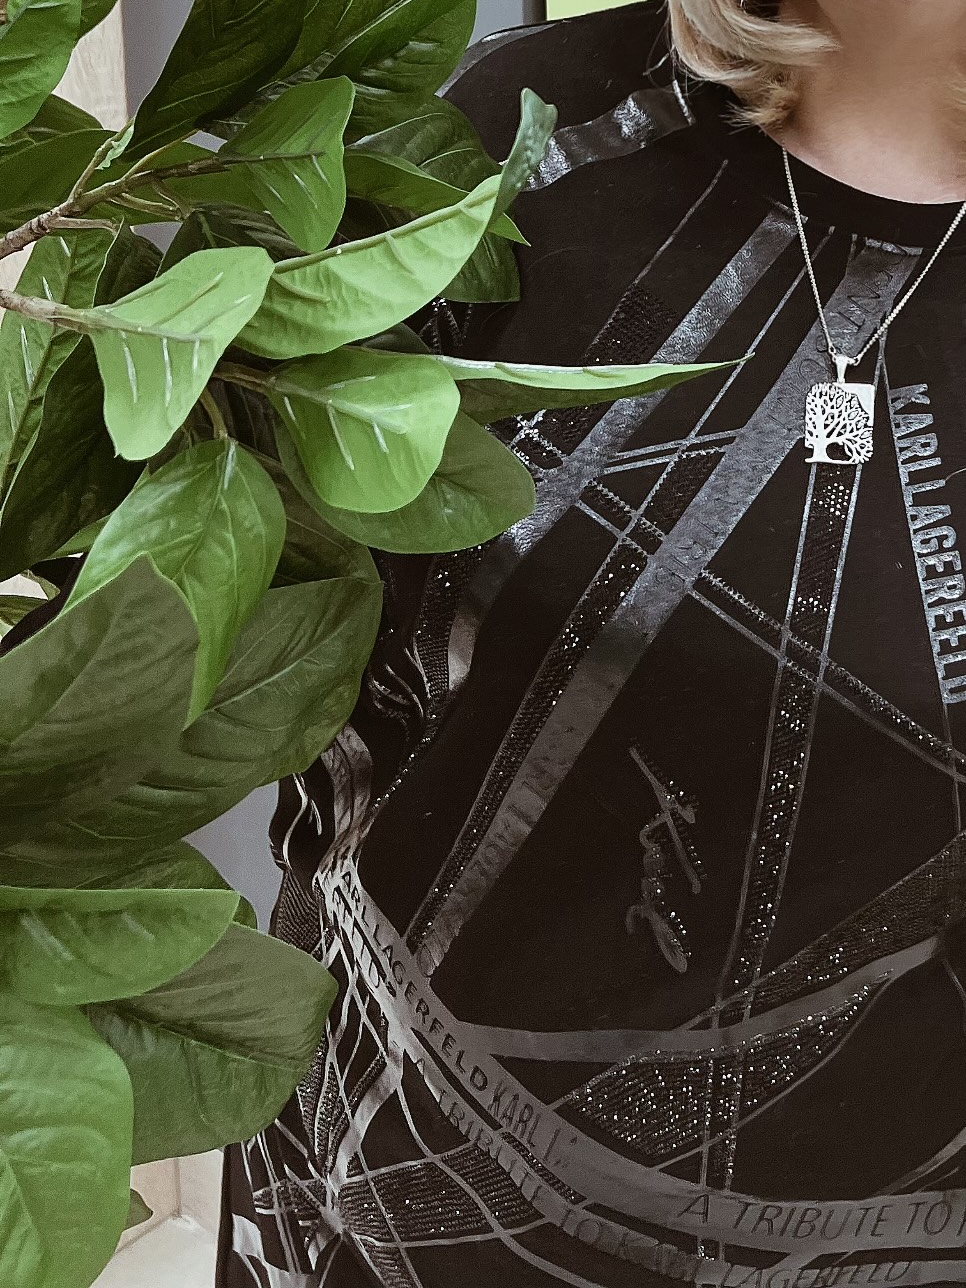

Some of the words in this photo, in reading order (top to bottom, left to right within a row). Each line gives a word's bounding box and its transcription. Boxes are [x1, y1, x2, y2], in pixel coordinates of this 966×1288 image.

[373, 924, 489, 1092] LAGERFELD
[677, 1194, 710, 1224] A
[734, 1201, 893, 1240] TRIBUTE
[906, 1200, 951, 1235] TO
